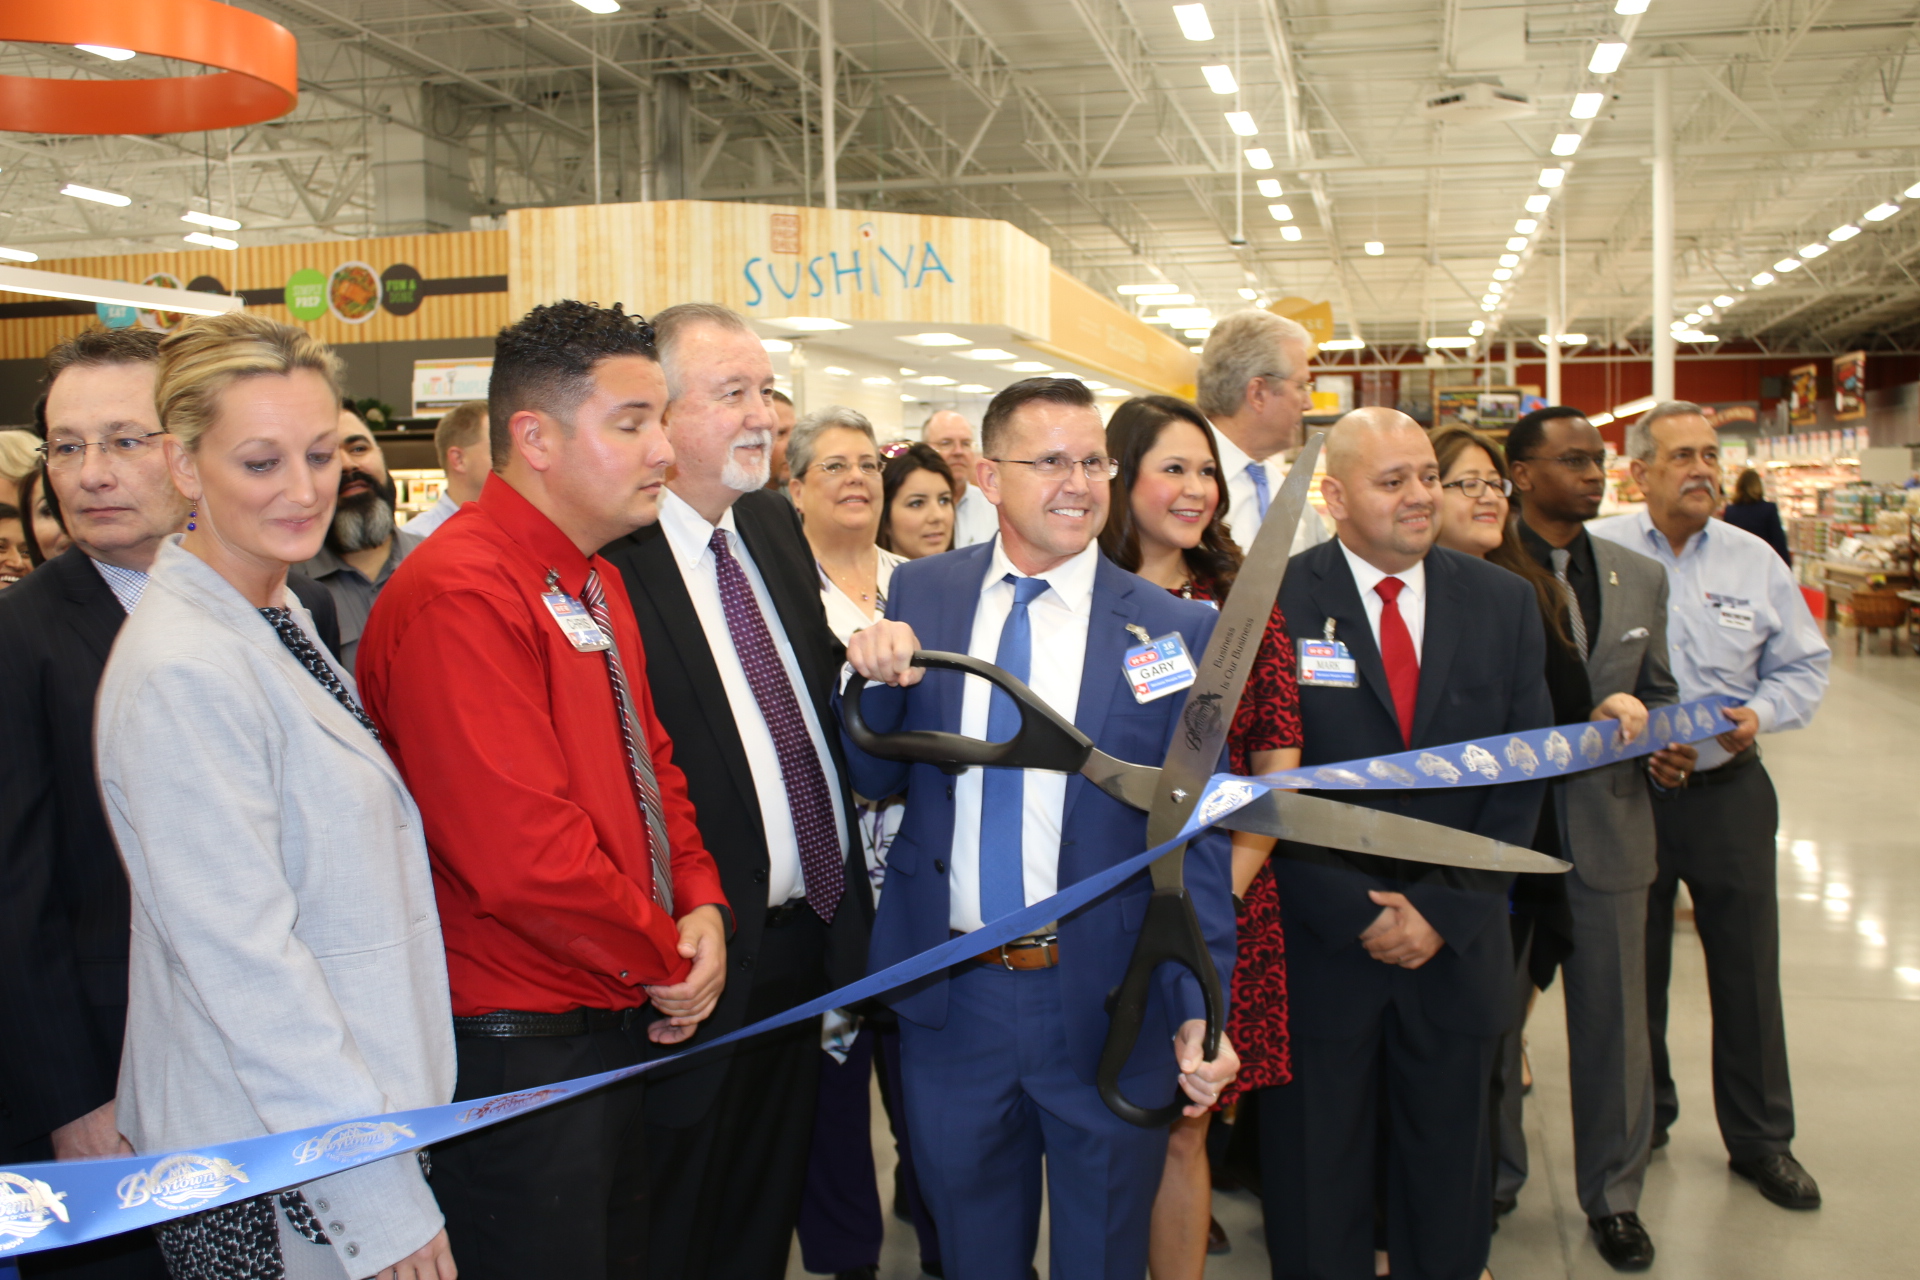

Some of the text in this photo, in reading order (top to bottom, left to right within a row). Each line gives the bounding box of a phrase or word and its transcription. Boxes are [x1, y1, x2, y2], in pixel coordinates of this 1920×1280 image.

[294, 296, 321, 308] PREP
[1213, 626, 1236, 669] Business
[1220, 617, 1254, 690] Is Our Business
[1140, 660, 1175, 679] GARY
[1316, 660, 1341, 671] MARK
[116, 1169, 216, 1210] Baytown
